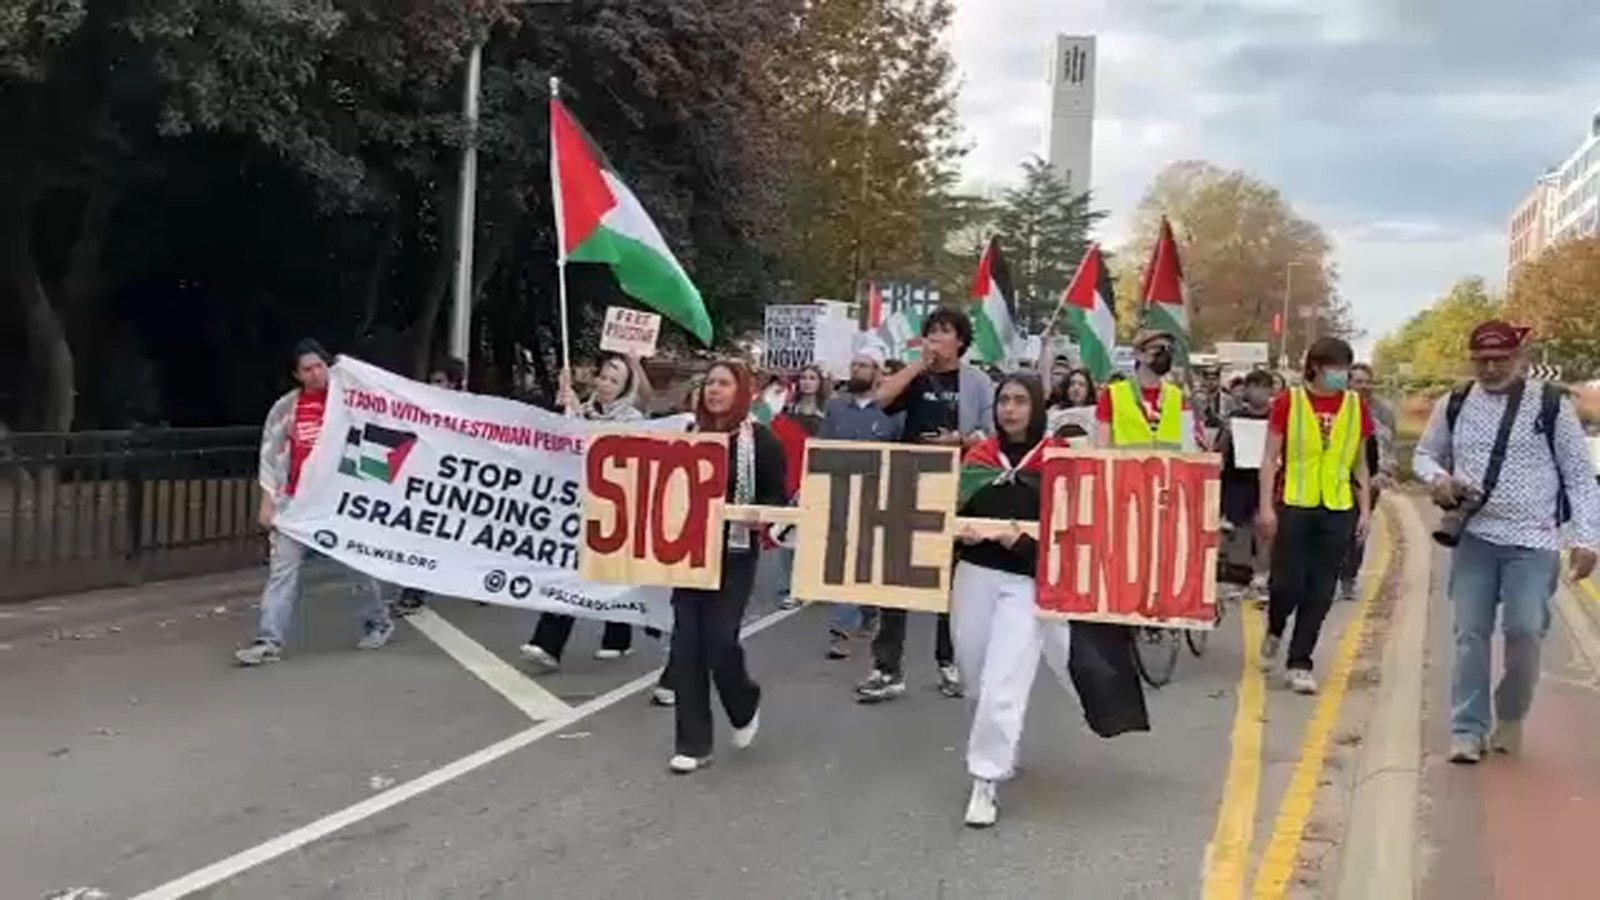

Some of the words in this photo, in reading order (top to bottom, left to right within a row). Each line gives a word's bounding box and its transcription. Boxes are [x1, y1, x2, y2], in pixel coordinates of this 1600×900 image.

[391, 399, 431, 425] WITH
[404, 476, 552, 532] FUNDING
[437, 454, 523, 492] STOP
[530, 473, 582, 508] U.S.
[586, 435, 727, 568] STOP
[336, 491, 467, 542] ISRAELI
[807, 448, 954, 589] THE
[1035, 456, 1221, 621] GENOCIDE
[345, 539, 438, 571] PSLWEB.ORG
